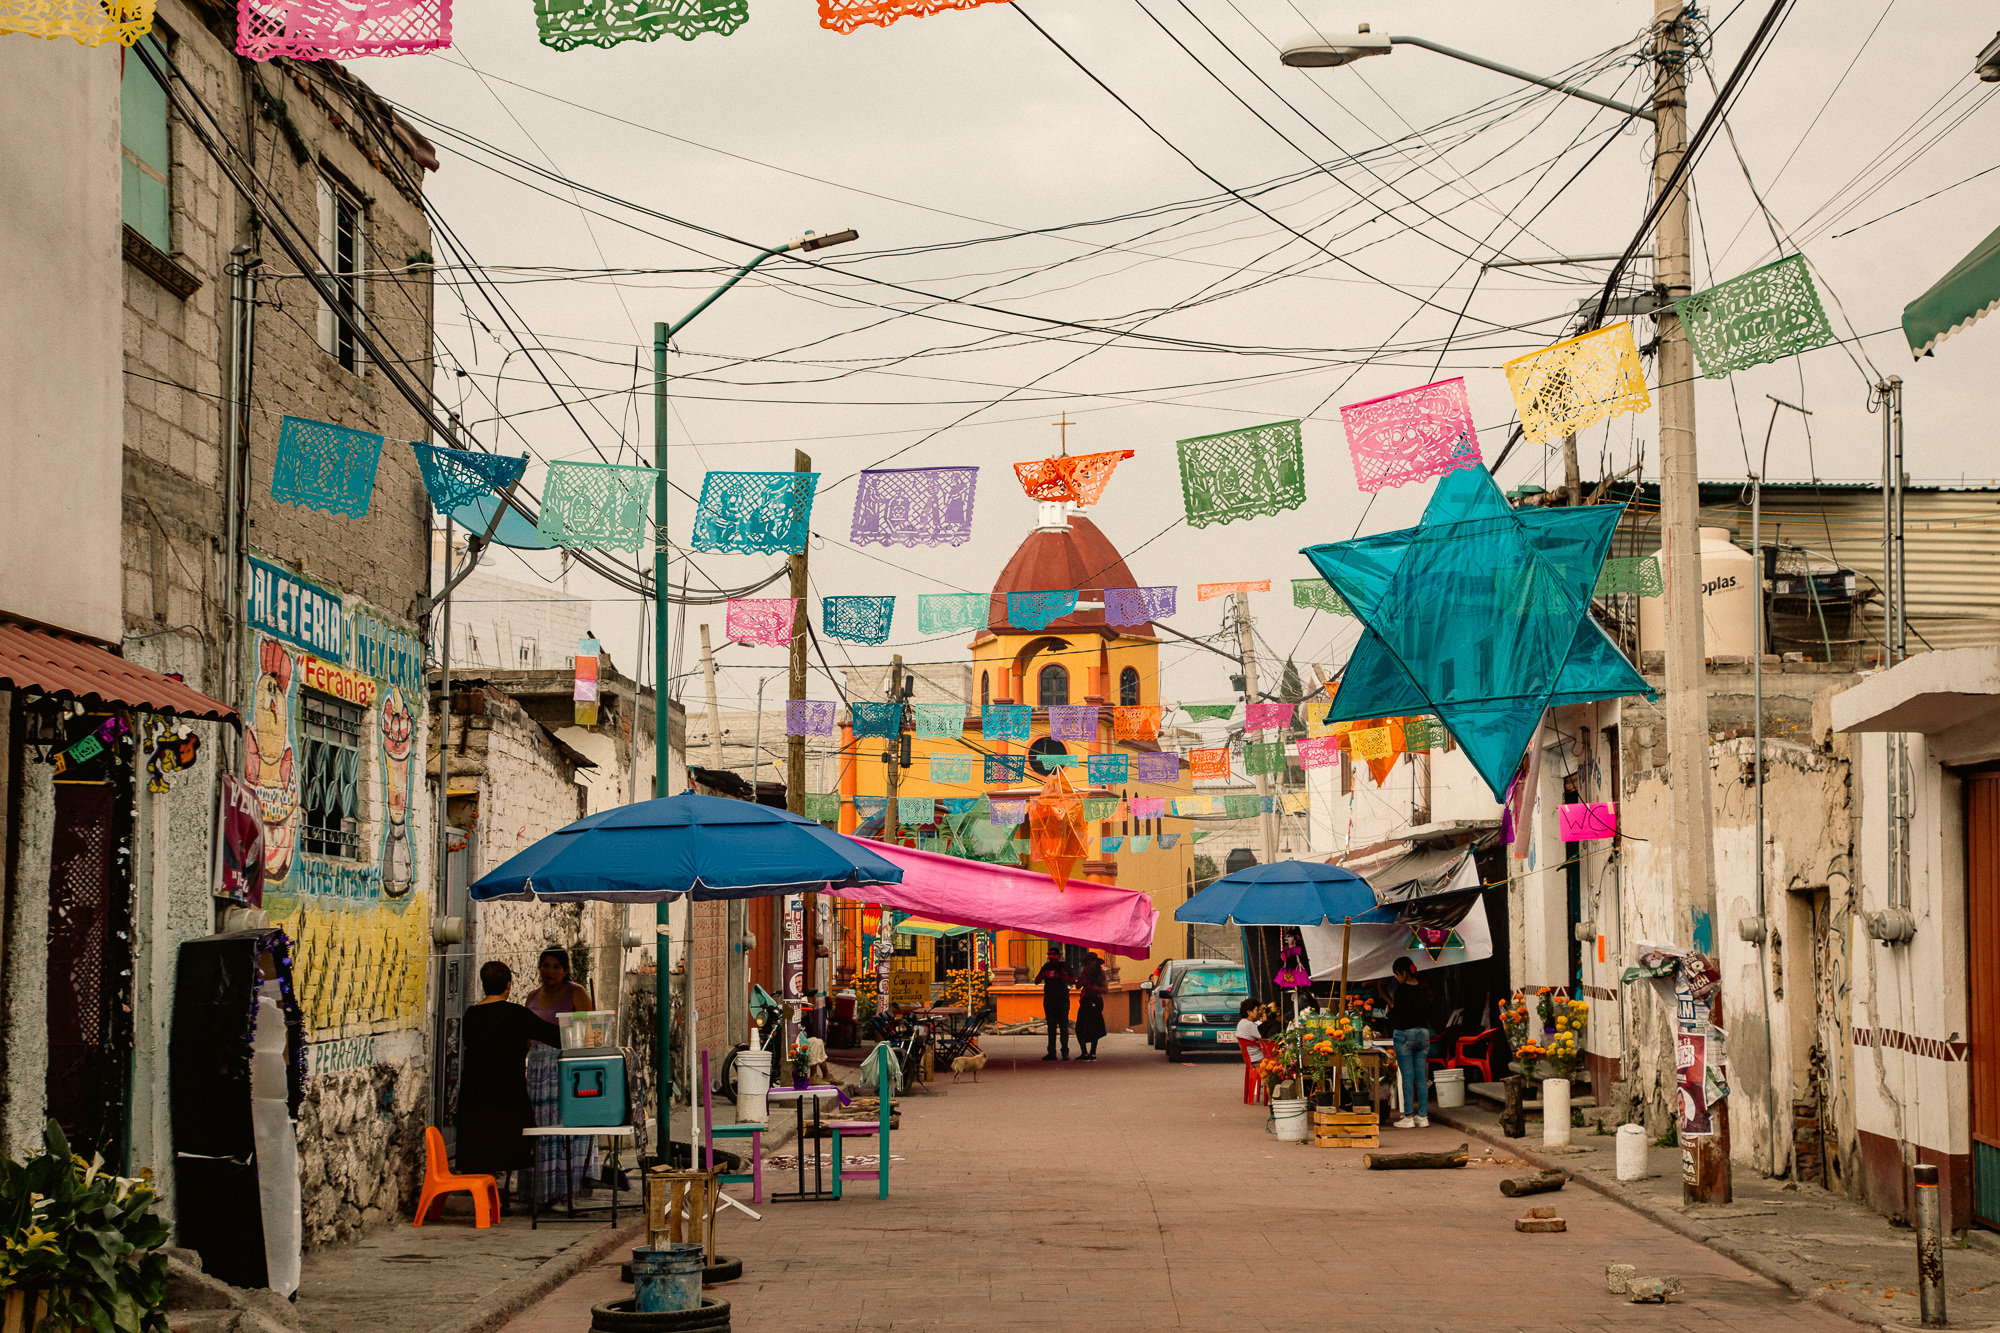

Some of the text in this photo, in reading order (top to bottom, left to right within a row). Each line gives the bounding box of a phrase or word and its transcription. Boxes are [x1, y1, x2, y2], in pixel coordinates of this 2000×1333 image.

[358, 613, 421, 693] NEVERIA
[1561, 805, 1609, 831] WC
[315, 1037, 376, 1076] PERRONAS
